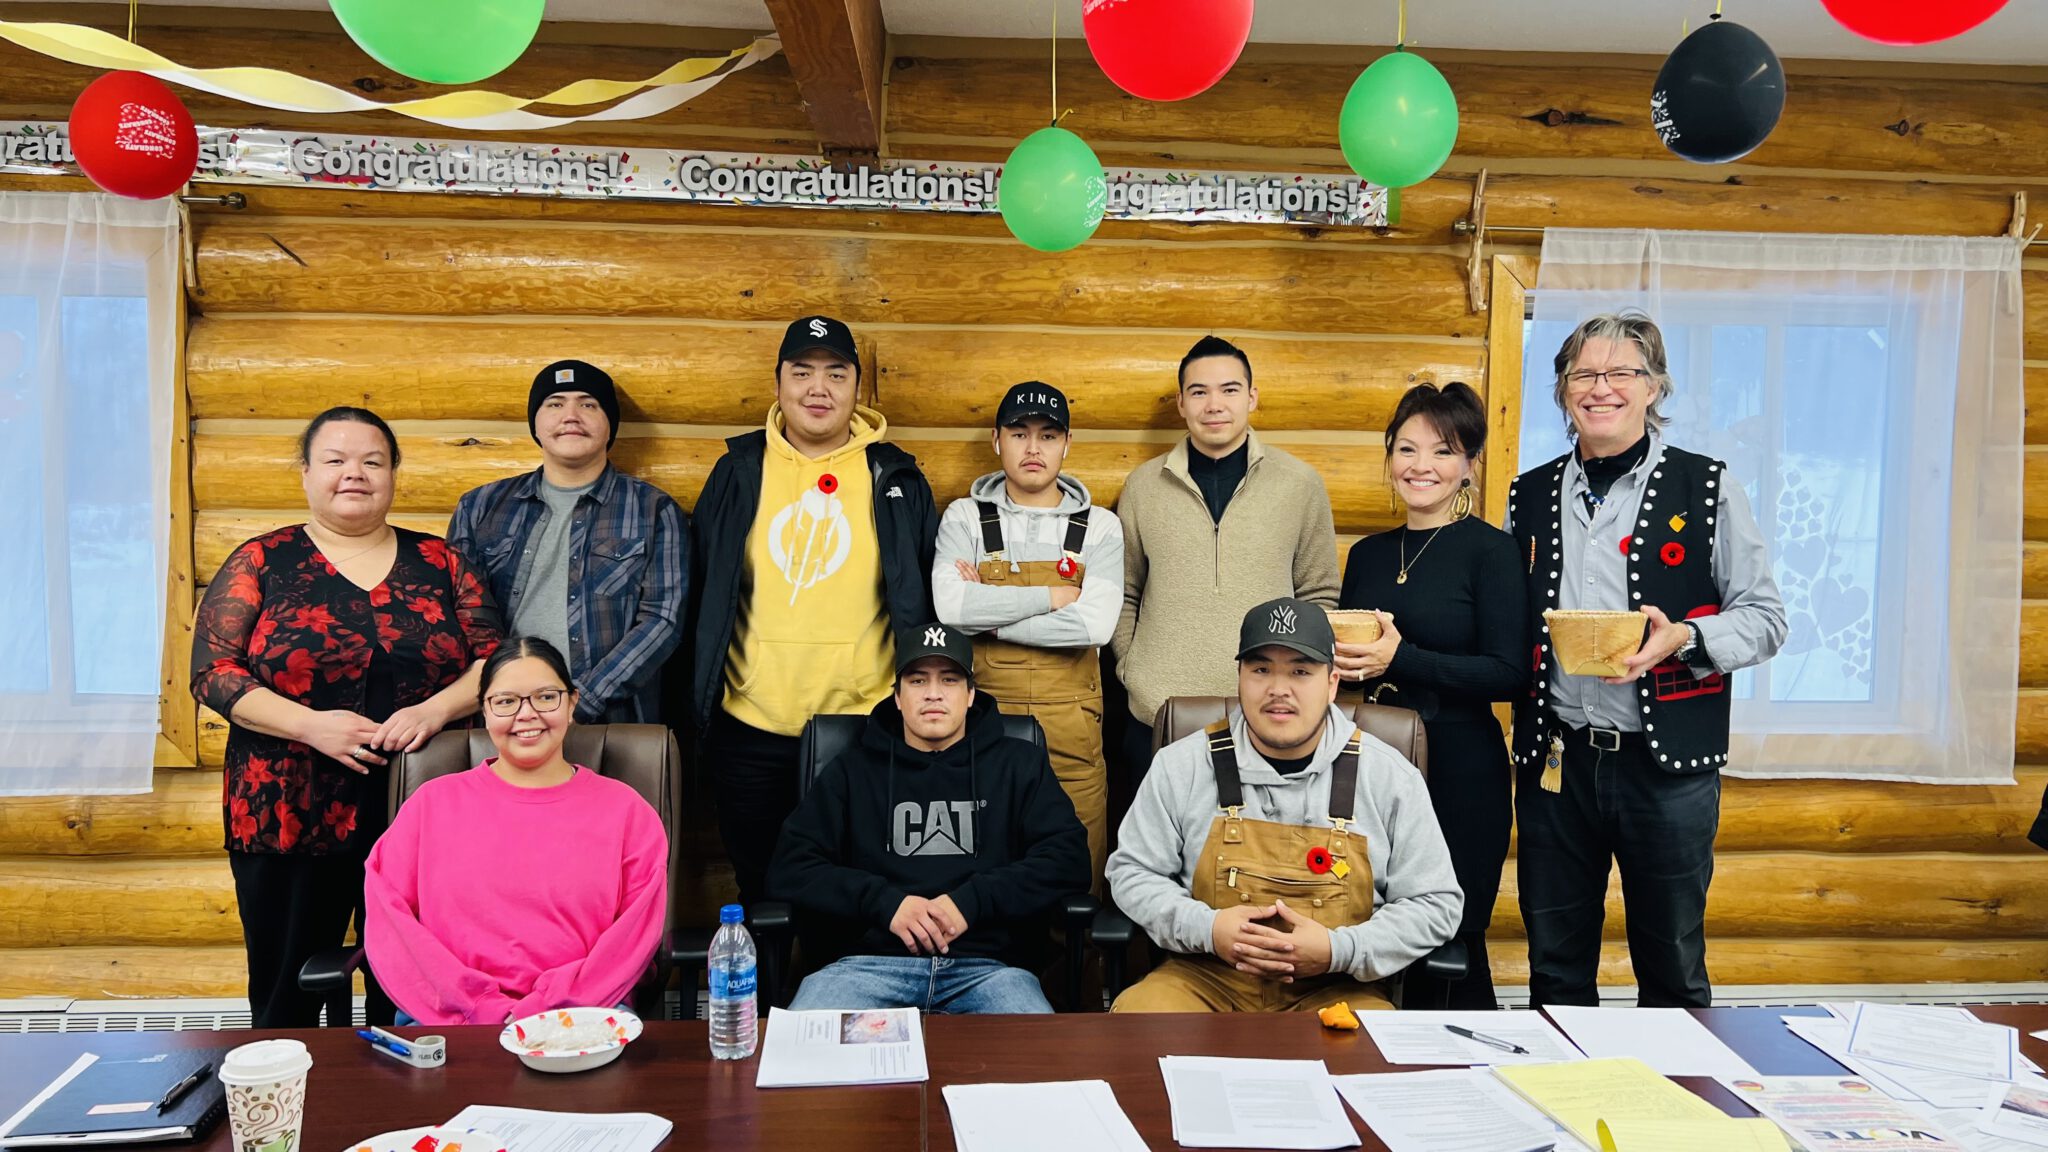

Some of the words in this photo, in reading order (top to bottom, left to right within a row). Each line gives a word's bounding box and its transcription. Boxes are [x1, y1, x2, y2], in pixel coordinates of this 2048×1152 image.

[293, 140, 618, 187] Congratulations!
[681, 158, 994, 202] Congratulations!
[1106, 178, 1358, 215] ngratulations!
[1017, 392, 1058, 408] KING
[893, 801, 974, 856] CAT
